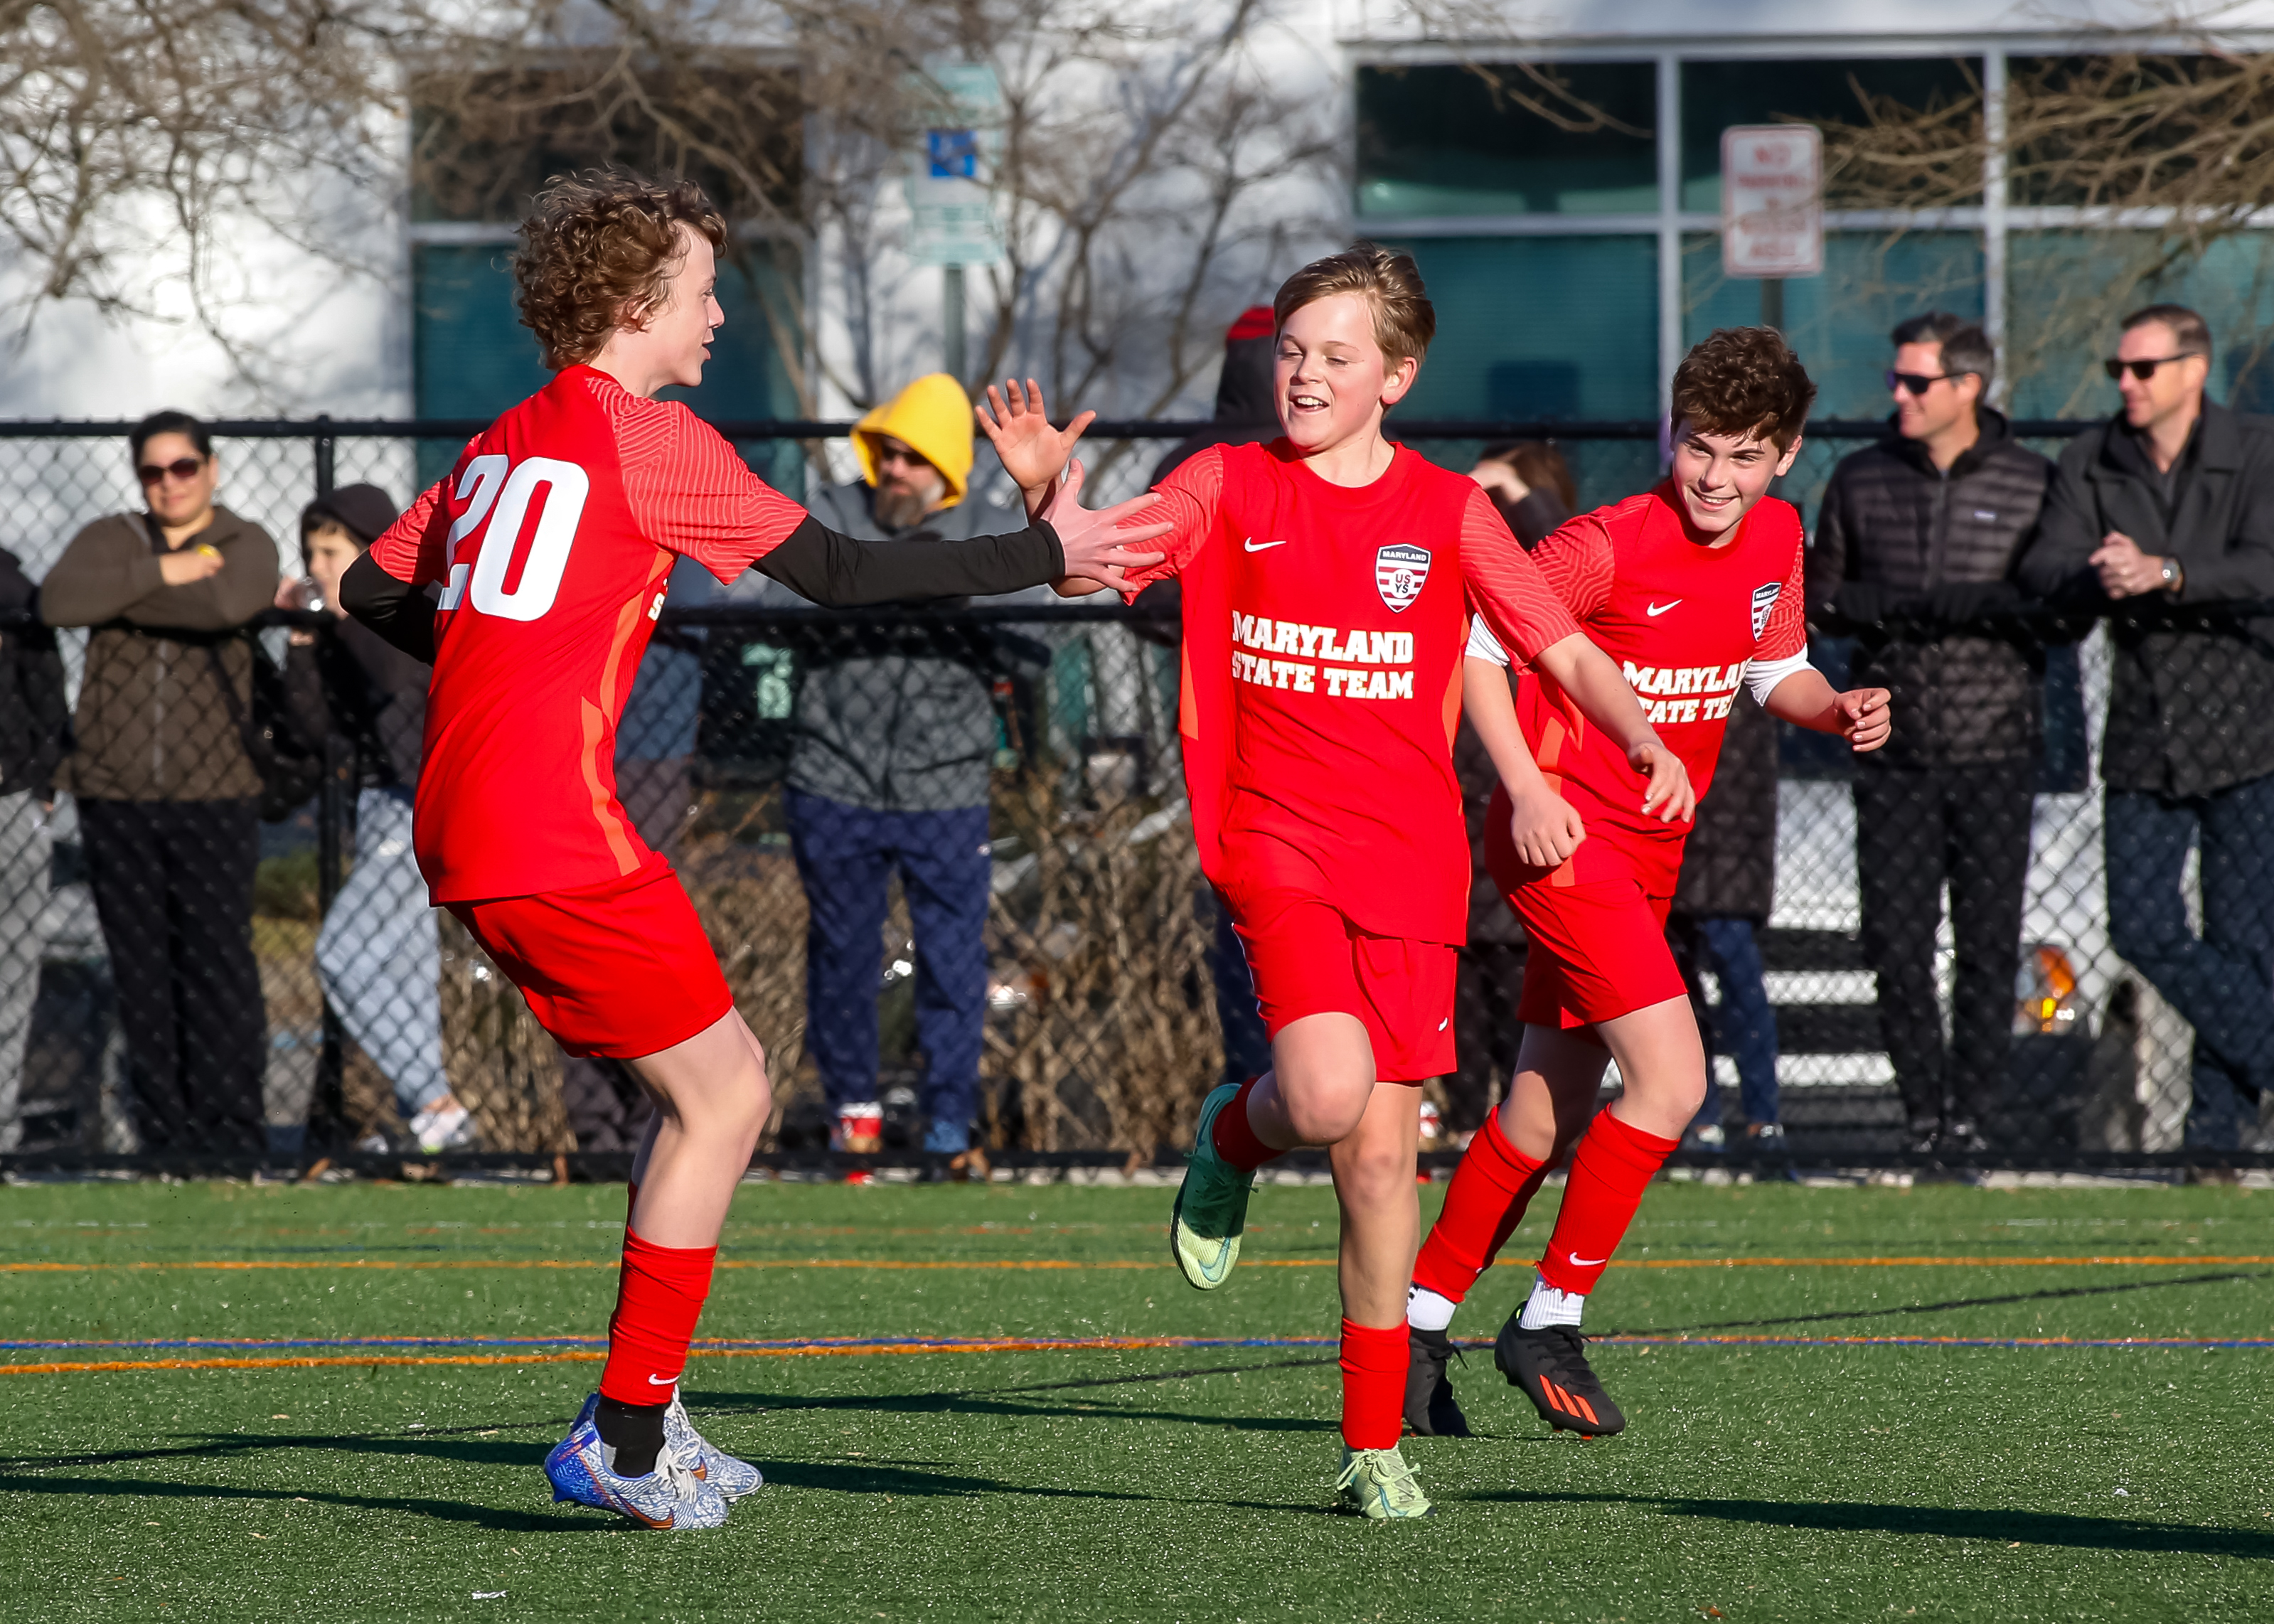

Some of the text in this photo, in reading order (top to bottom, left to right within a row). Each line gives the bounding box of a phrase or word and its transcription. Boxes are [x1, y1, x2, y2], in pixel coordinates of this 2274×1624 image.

[437, 454, 590, 622] 20
[1382, 550, 1427, 562] MARYLAND
[1395, 573, 1411, 584] US
[1395, 582, 1409, 594] YS
[1232, 609, 1415, 665] MARYLAND
[1232, 650, 1415, 700] STATE TEAM
[1622, 657, 1751, 695] MARYLA
[1702, 691, 1735, 721] TE
